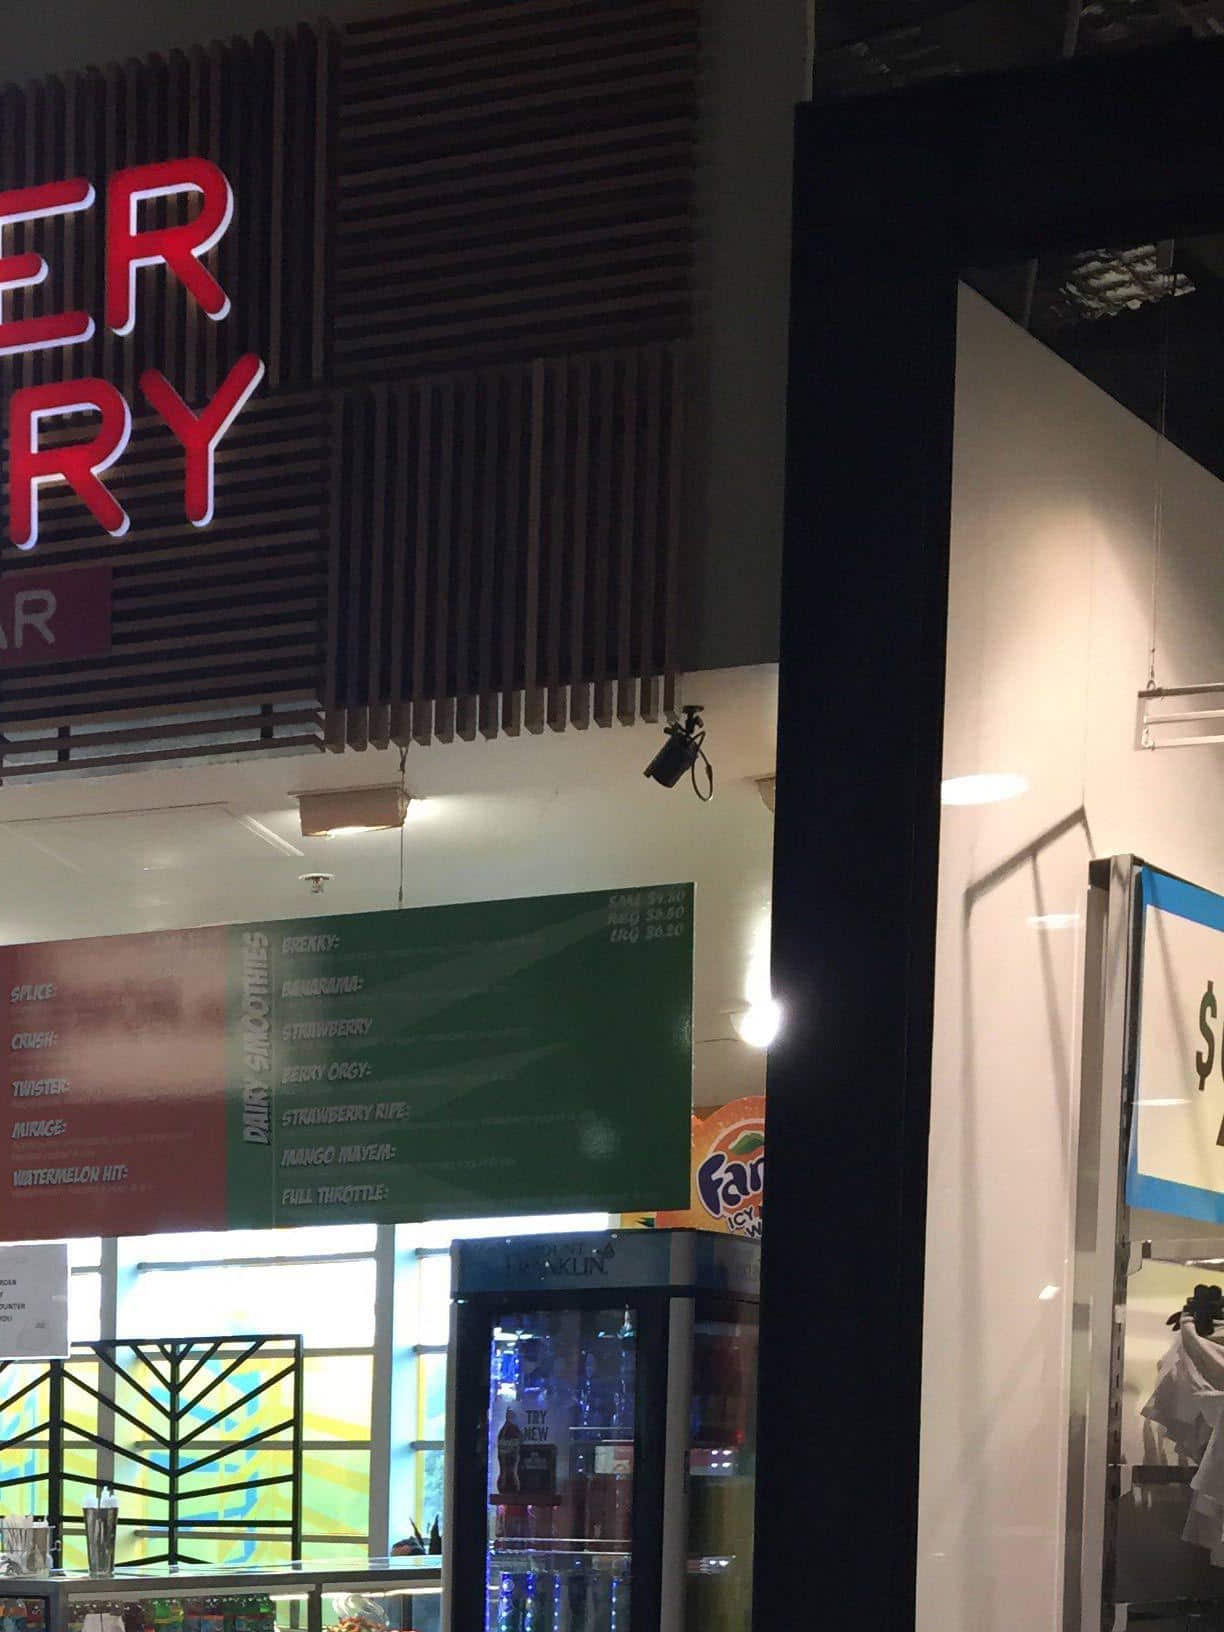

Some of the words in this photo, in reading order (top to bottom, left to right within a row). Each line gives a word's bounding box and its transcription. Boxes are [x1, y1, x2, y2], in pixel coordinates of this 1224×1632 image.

[241, 932, 272, 1072] SMOOTHIES
[241, 1079, 272, 1145] DAIRY
[281, 1104, 374, 1127] STRAWBERRY
[281, 1147, 335, 1167] MANGO
[13, 1166, 100, 1187] WATERMELON
[102, 1164, 128, 1182] HIT:
[698, 1152, 765, 1219] Fan
[281, 1186, 313, 1205] FULL
[317, 1183, 389, 1204] THROTTLE:
[728, 1207, 754, 1229] ICY
